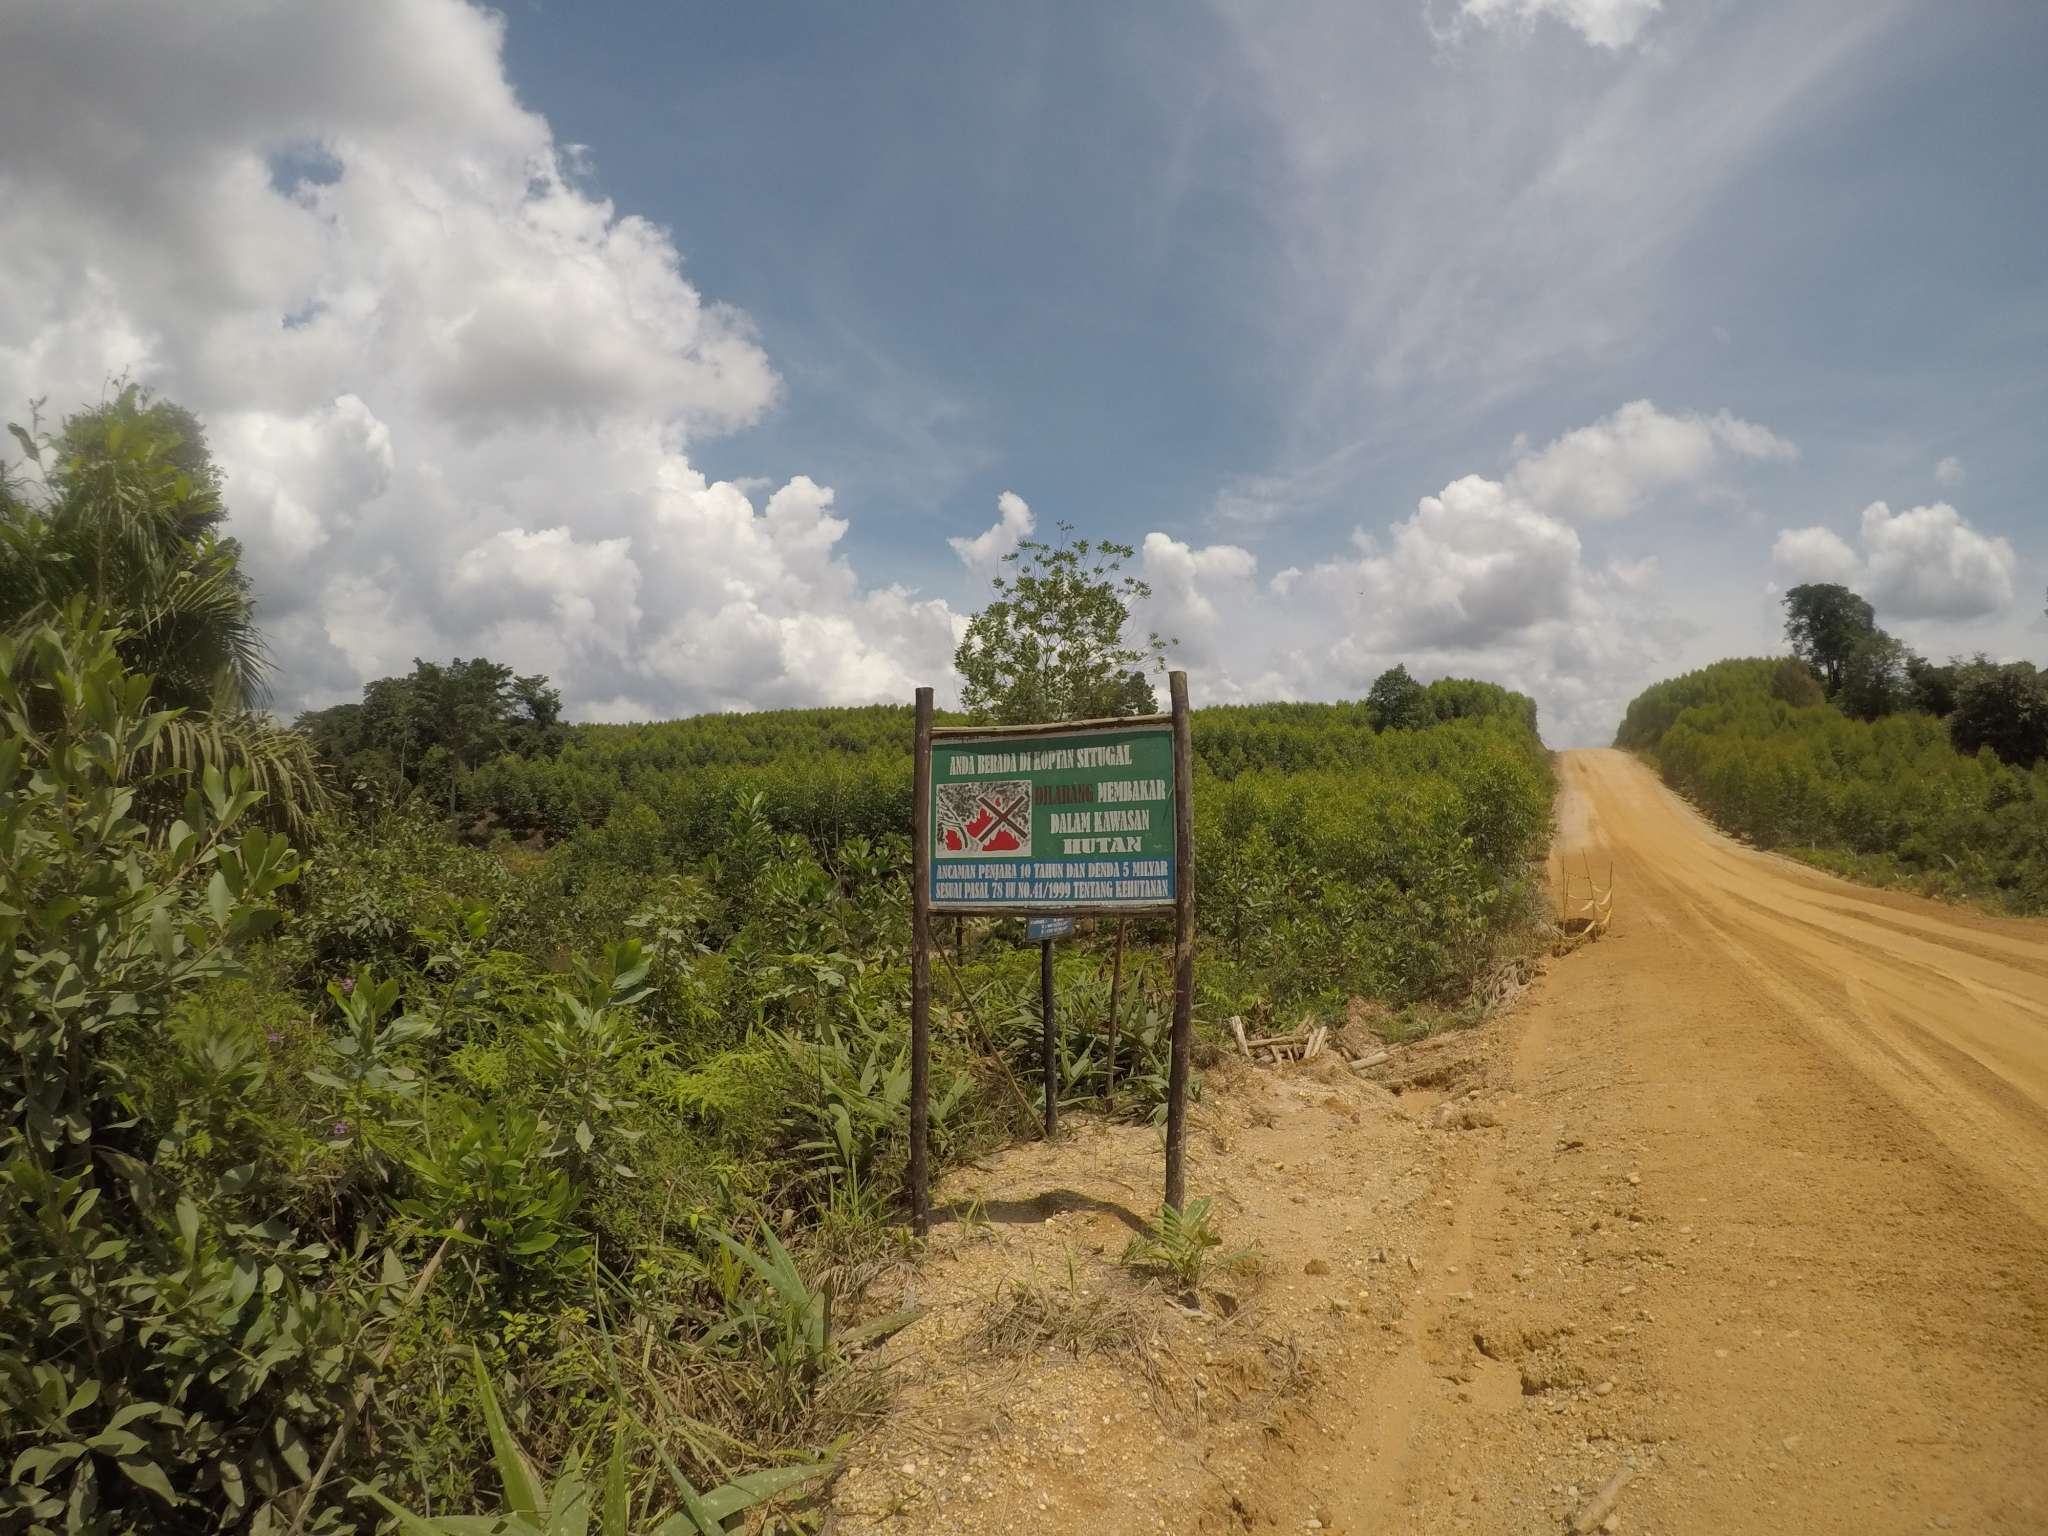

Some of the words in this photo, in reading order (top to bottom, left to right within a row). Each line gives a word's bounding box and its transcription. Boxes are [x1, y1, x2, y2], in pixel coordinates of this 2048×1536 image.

[950, 756, 975, 775] ANDA
[978, 754, 1016, 773] BERADA
[1020, 752, 1032, 771] DI
[1035, 784, 1094, 805] DILARANG
[1098, 780, 1166, 802] MEMBAKAR
[1050, 812, 1091, 834] DALAM
[1094, 810, 1149, 832] KAWASAN
[1063, 837, 1142, 854] HUTAN
[936, 864, 976, 879] ANCAMAN
[978, 864, 1017, 879] PENJARA
[1034, 864, 1064, 879] TAHUN
[1067, 864, 1086, 878] DAN
[1088, 863, 1119, 878] DENDA
[1123, 862, 1129, 877] 5
[1133, 861, 1168, 877] MILYAR
[936, 883, 962, 898] SESUAI
[964, 883, 989, 898] PASAL
[992, 882, 1003, 898] 78
[1005, 882, 1016, 898] UU
[1073, 881, 1113, 898] TENTANG
[1115, 879, 1168, 897] KEHUTANAN
